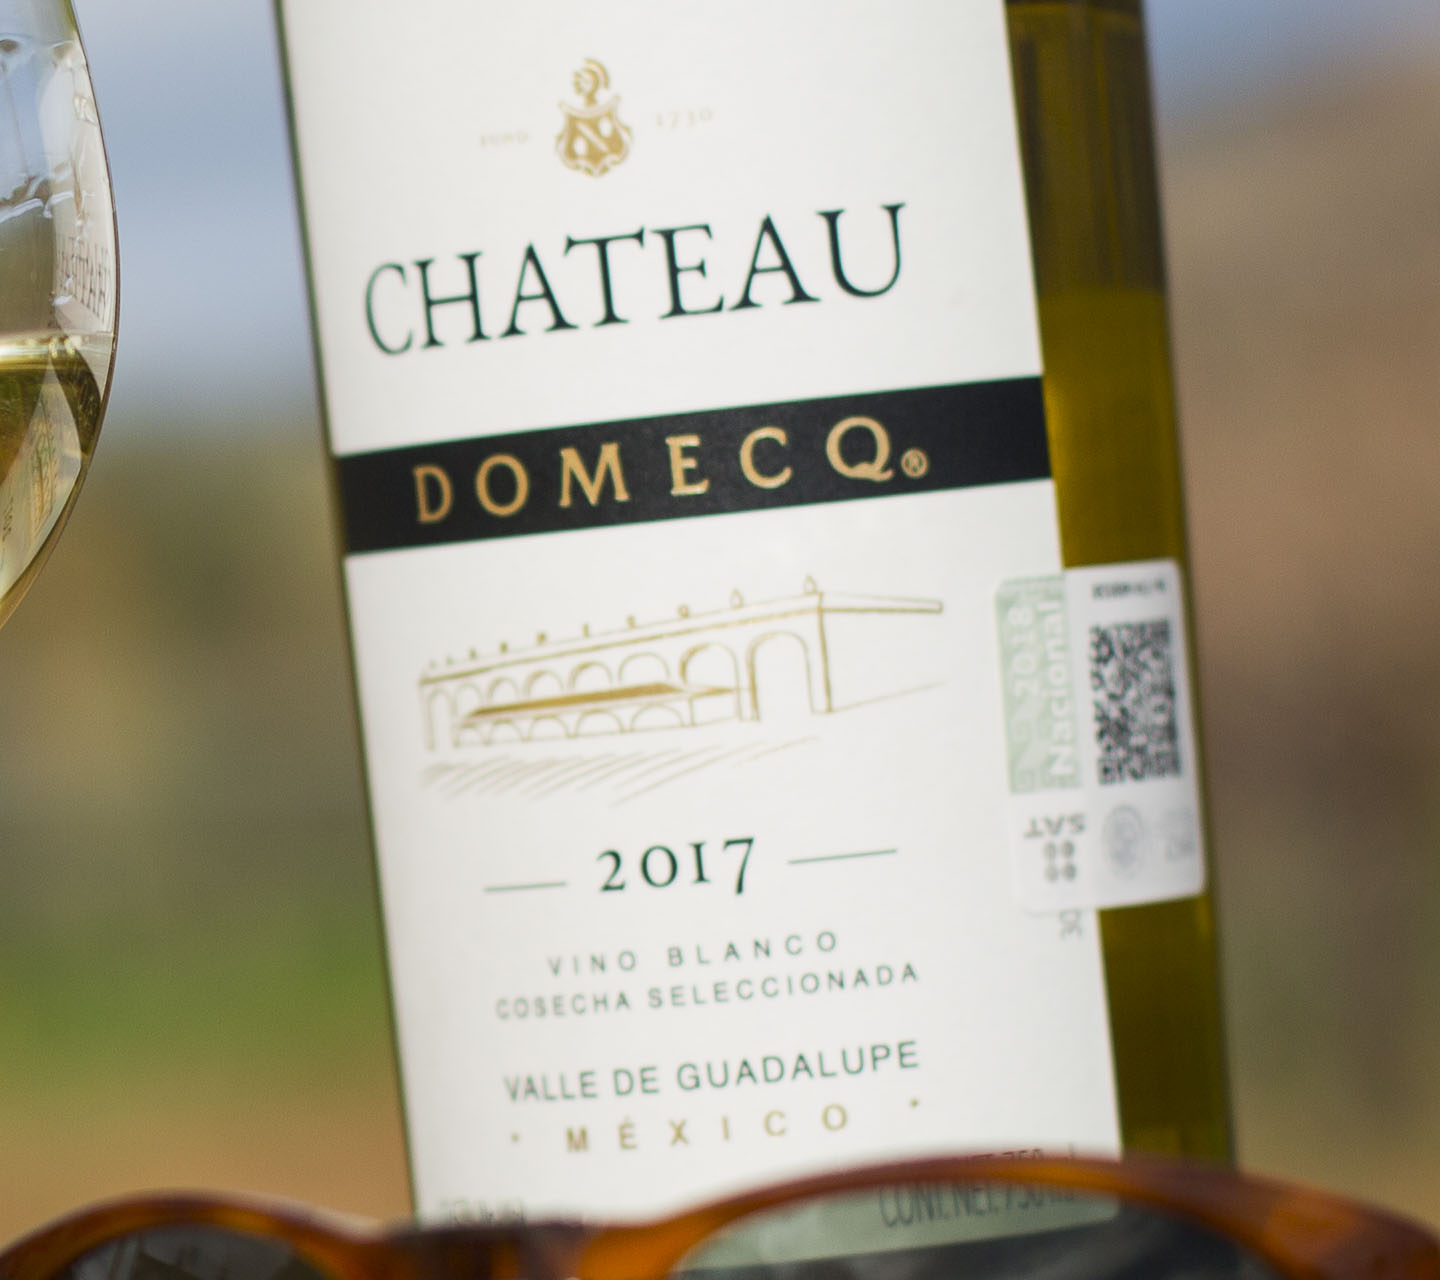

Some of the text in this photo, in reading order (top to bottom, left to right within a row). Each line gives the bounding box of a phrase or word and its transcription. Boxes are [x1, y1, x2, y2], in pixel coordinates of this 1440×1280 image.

[363, 202, 908, 357] CHATEAU
[1036, 599, 1076, 777] Nacional
[595, 837, 757, 895] 2017
[548, 931, 838, 976] VINO BLANCO
[496, 962, 919, 1020] COSECHA SELECCIONADA
[503, 1040, 920, 1102] VALLE DE GUADALUPE
[566, 1103, 848, 1153] MÉXICO
